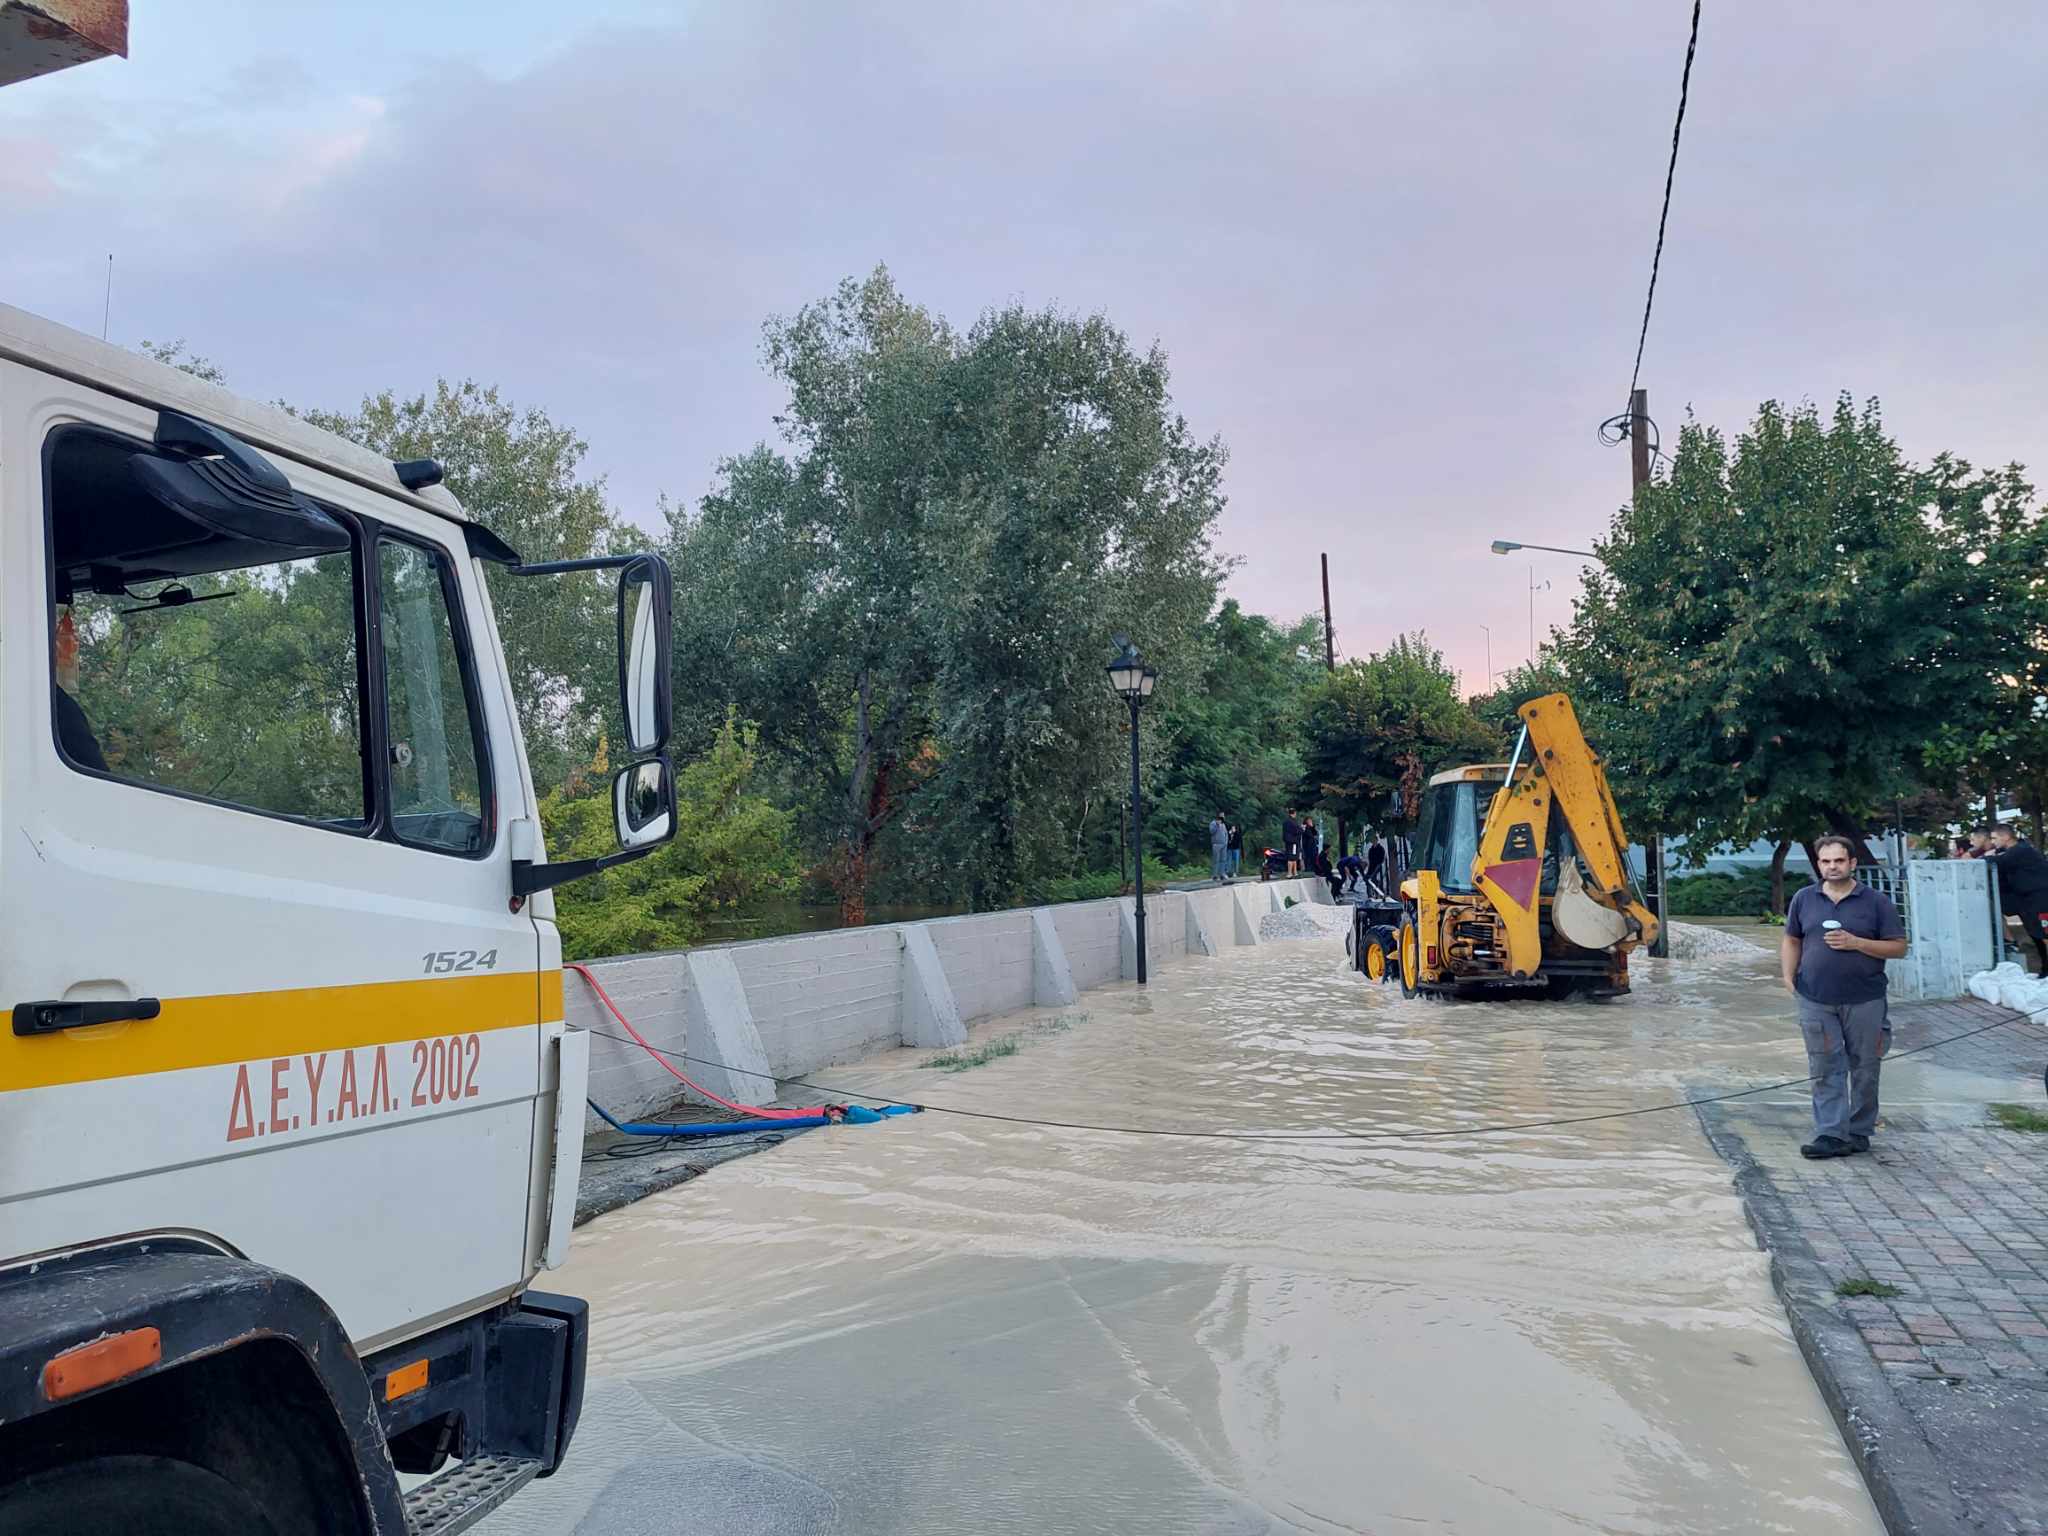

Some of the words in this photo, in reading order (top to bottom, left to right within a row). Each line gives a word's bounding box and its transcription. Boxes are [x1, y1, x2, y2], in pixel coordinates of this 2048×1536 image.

[422, 949, 497, 974] 1524
[227, 1045, 399, 1142] Δ.Ε.Υ.Α.Λ.
[411, 1033, 480, 1107] 2002
